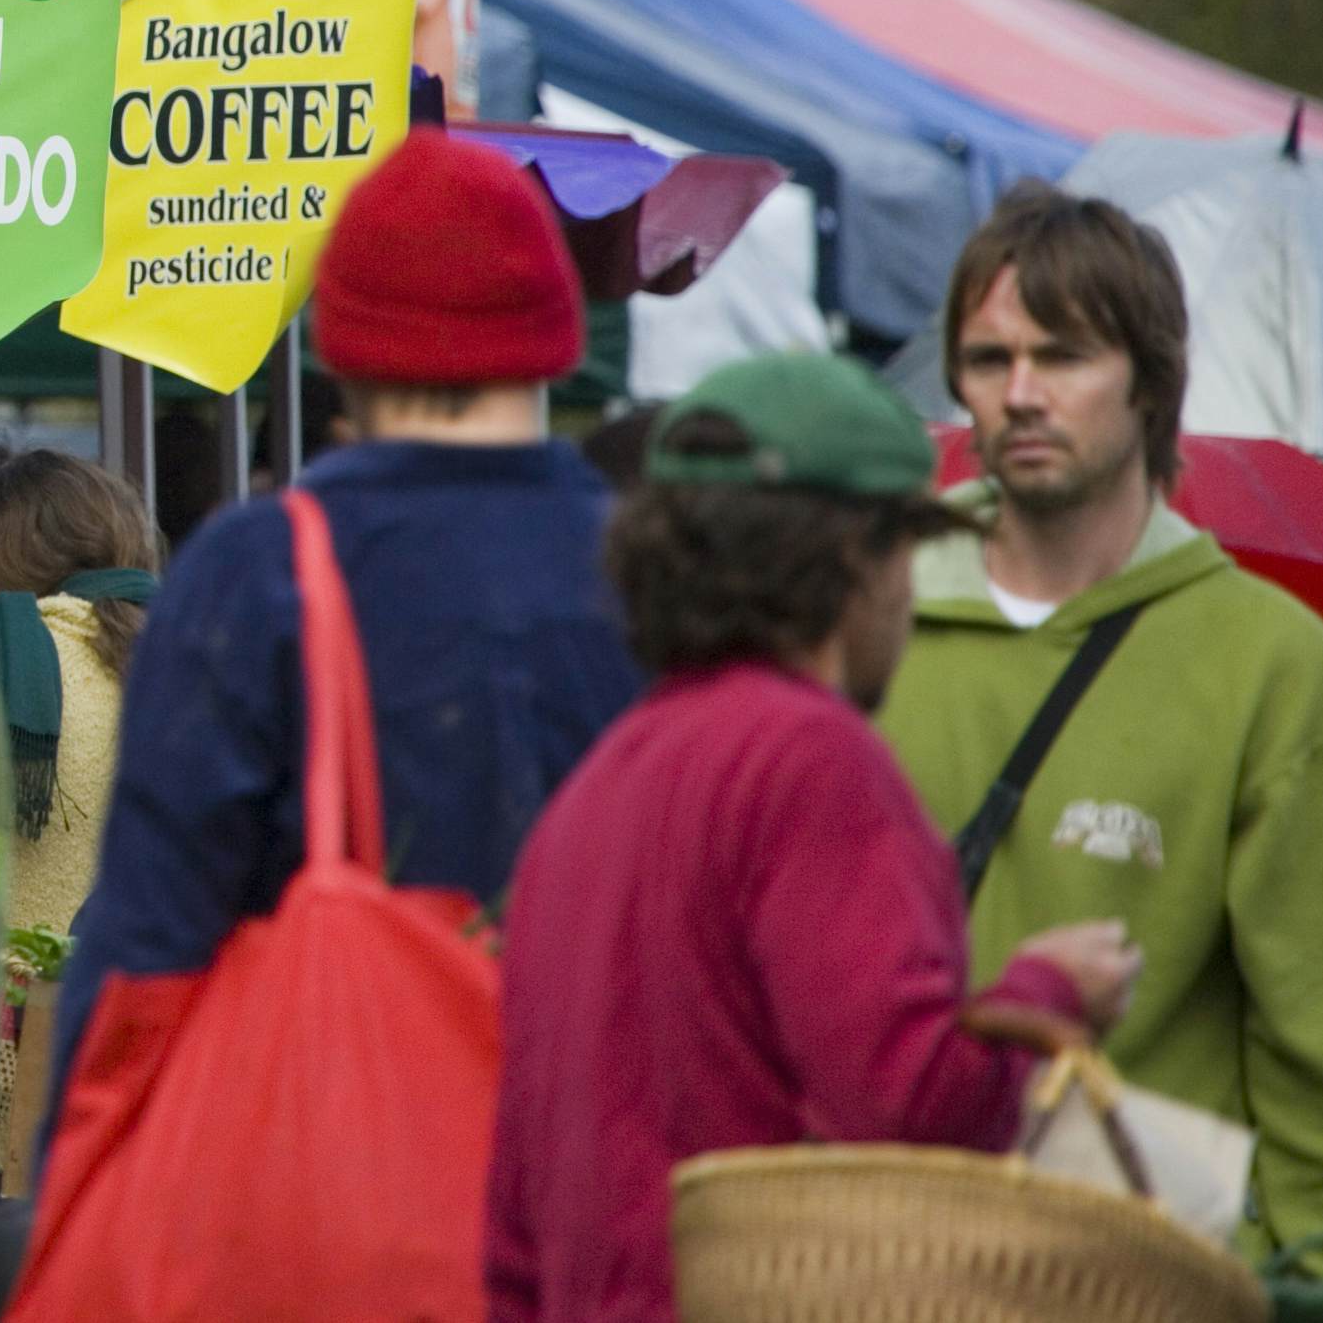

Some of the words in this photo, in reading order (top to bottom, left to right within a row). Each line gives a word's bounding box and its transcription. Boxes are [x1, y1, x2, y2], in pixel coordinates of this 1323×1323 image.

[144, 9, 348, 71] Bangalow
[109, 82, 374, 166] COFFEE
[149, 185, 288, 225] sundried
[300, 184, 326, 219] &
[127, 245, 273, 296] pesticide
